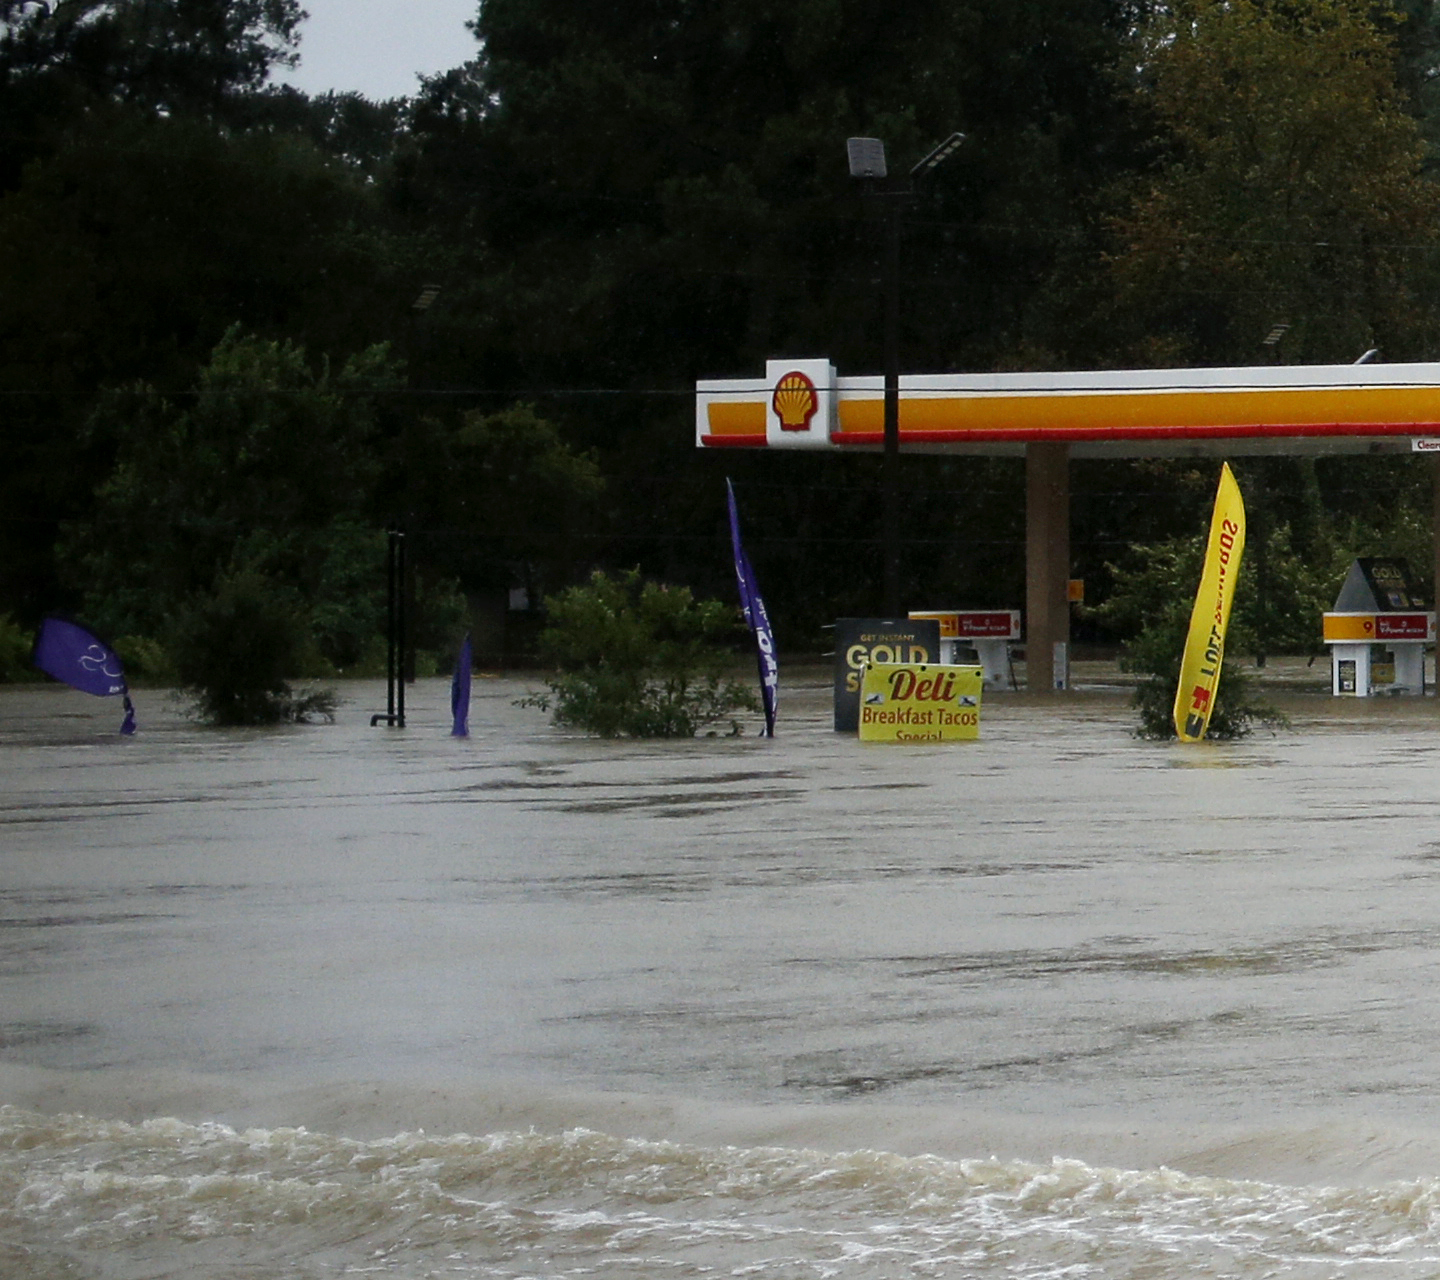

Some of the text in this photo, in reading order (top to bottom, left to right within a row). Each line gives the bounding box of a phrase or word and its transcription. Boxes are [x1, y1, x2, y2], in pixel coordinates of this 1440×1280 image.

[1363, 621, 1373, 633] 9
[861, 634, 915, 642] GET INSTANT
[889, 669, 957, 701] Deli
[863, 707, 978, 726] Breakfast Tacos
